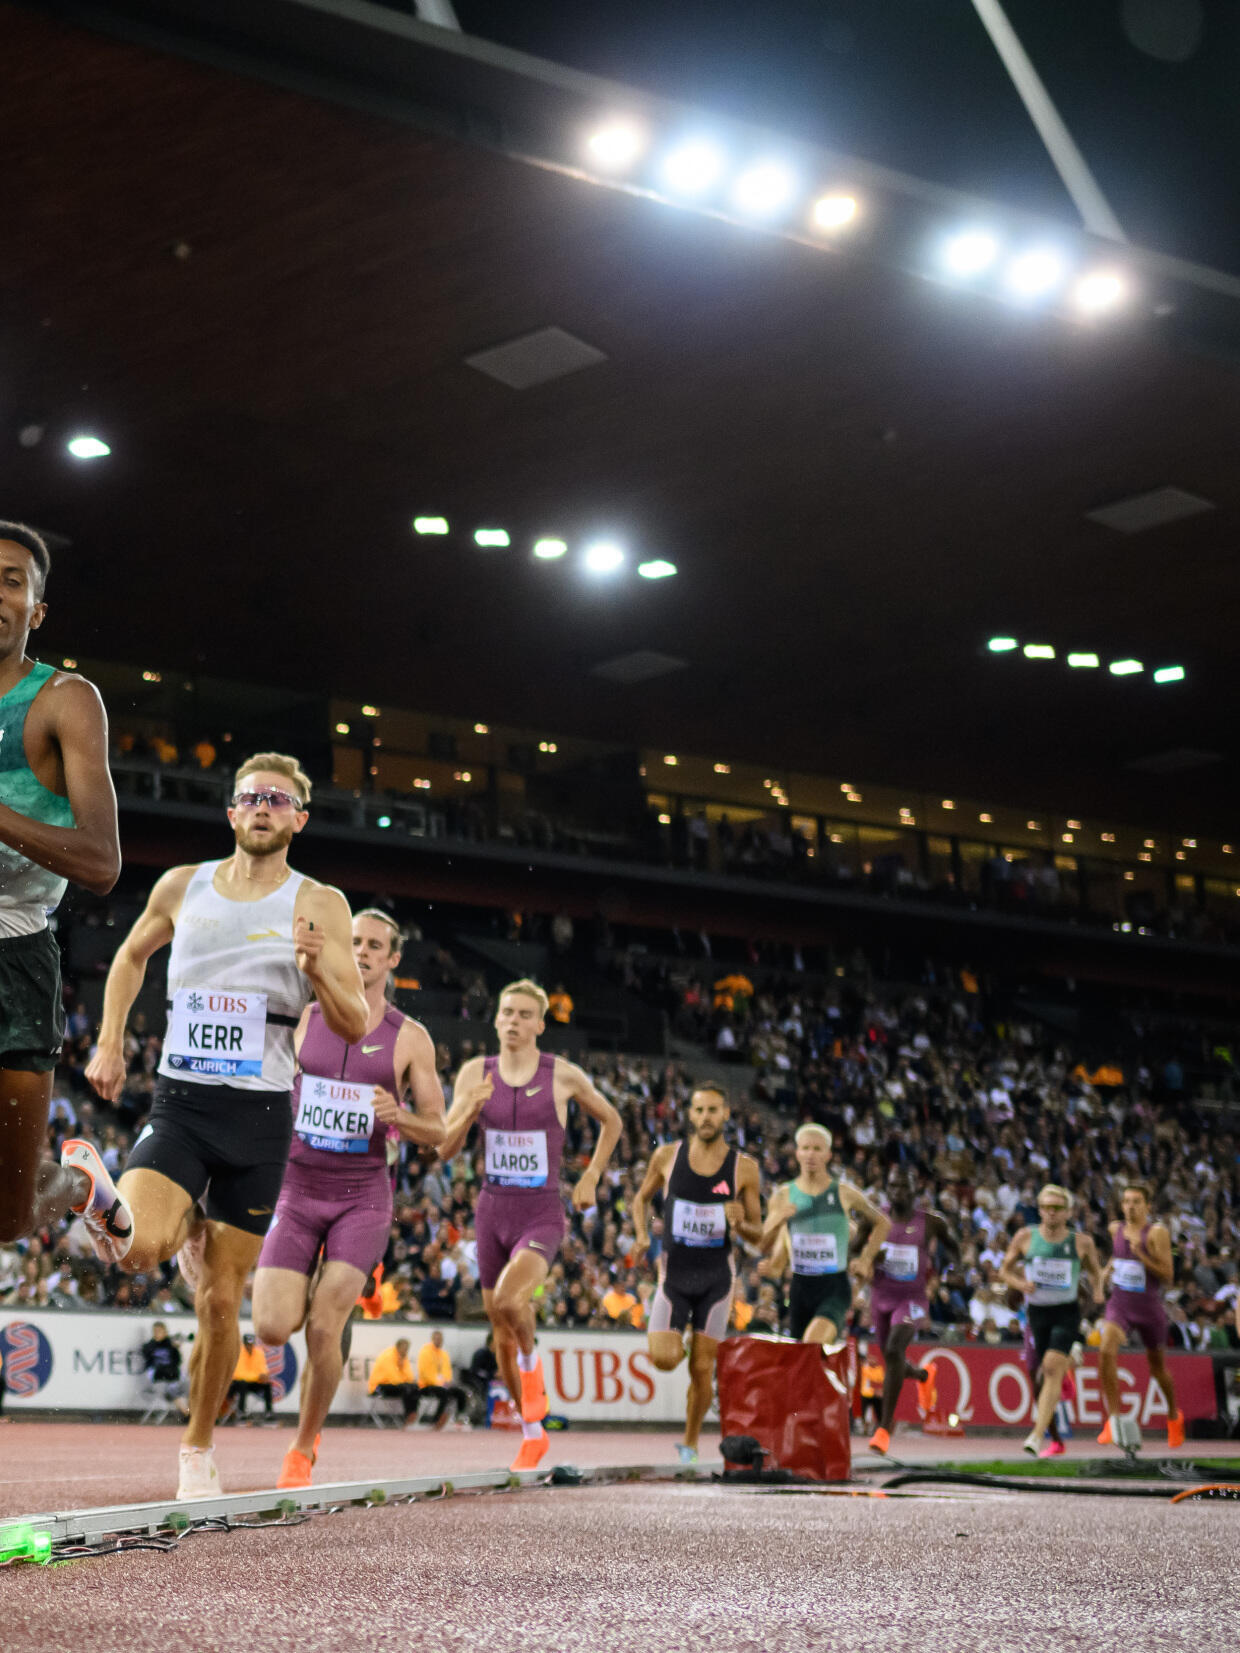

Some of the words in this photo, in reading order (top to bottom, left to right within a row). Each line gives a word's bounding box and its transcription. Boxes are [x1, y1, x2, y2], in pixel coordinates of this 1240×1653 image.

[209, 996, 248, 1015] UBS
[188, 1022, 243, 1051] KERR
[190, 1059, 237, 1073] ZURICH
[329, 1085, 360, 1101] UBS
[301, 1104, 369, 1135] HOCKER
[310, 1136, 350, 1150] ZURICH
[508, 1135, 534, 1147] UBS
[493, 1152, 538, 1171] LAROS
[549, 1348, 655, 1405] UBS
